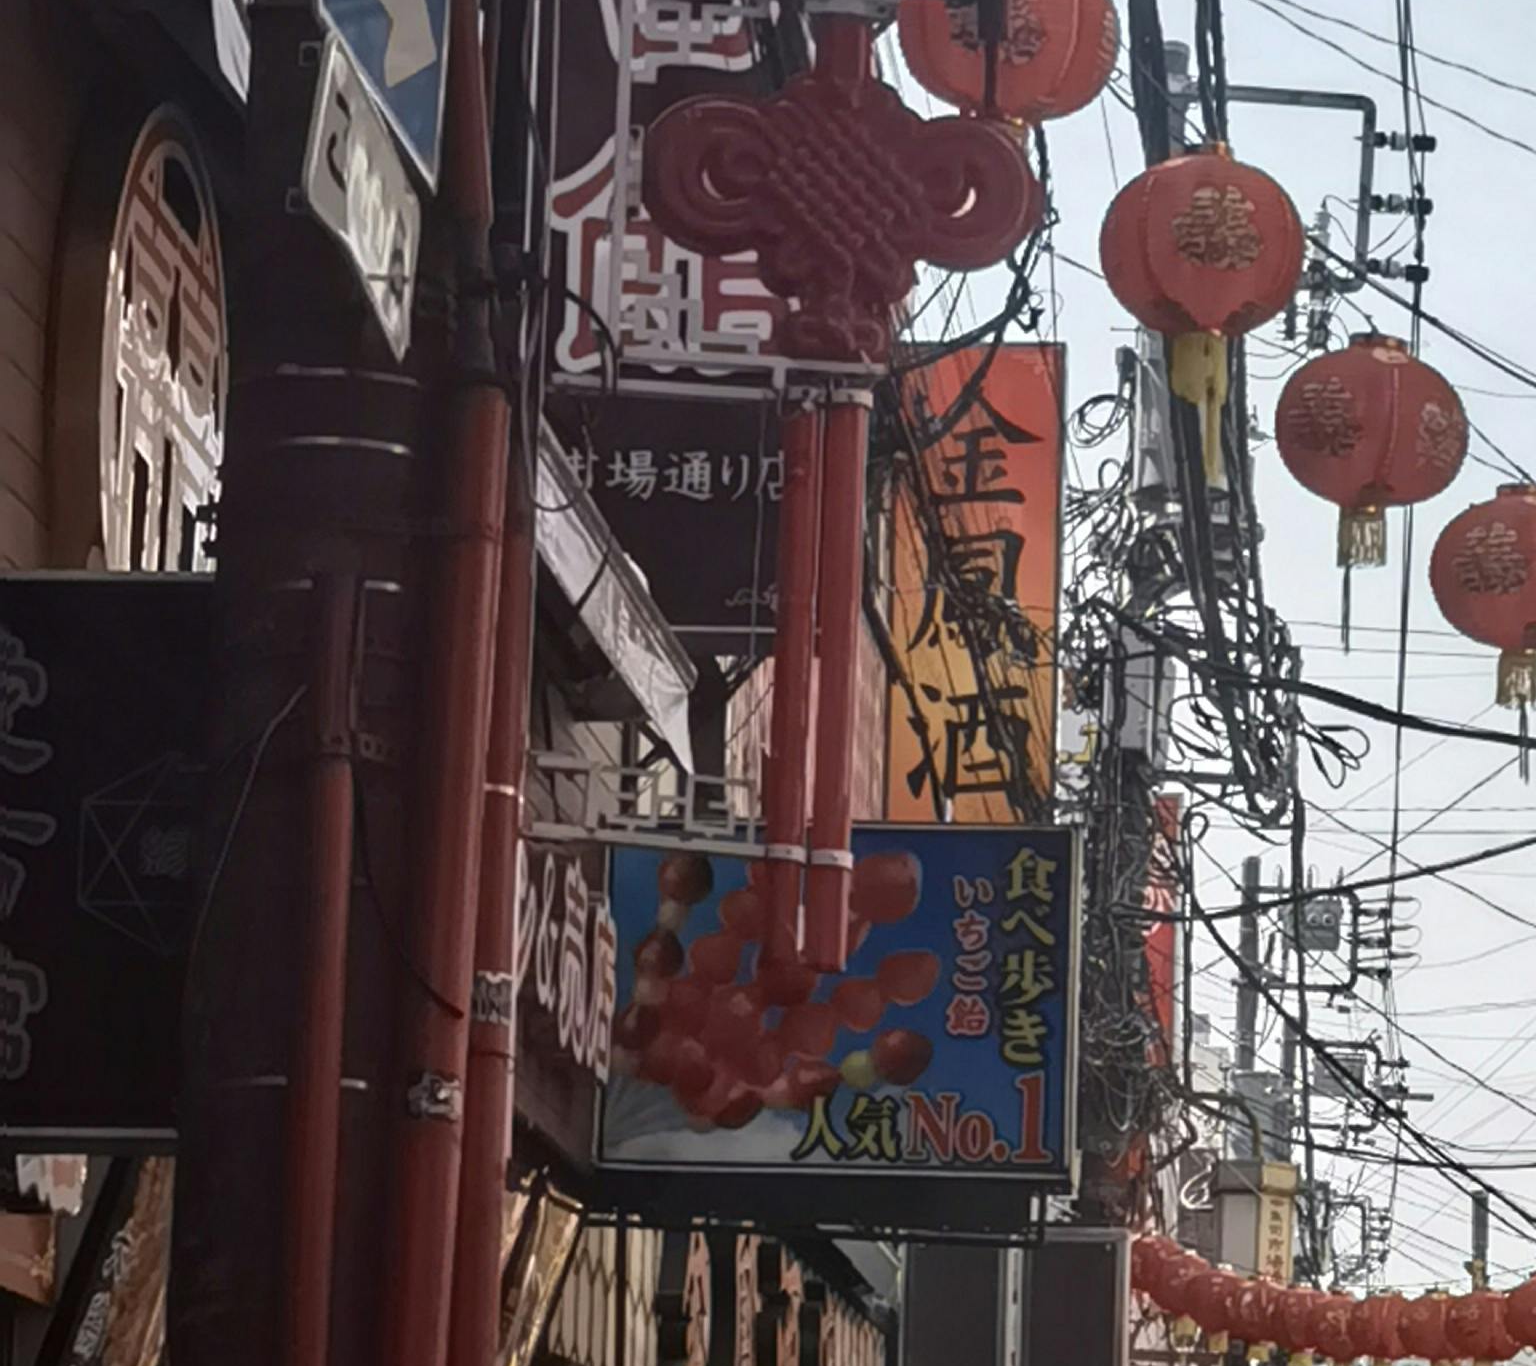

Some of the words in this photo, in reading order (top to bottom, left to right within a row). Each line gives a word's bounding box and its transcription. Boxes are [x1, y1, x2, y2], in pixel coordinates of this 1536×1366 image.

[945, 874, 996, 1038] いちご飴
[999, 846, 1057, 1066] 食べ歩き
